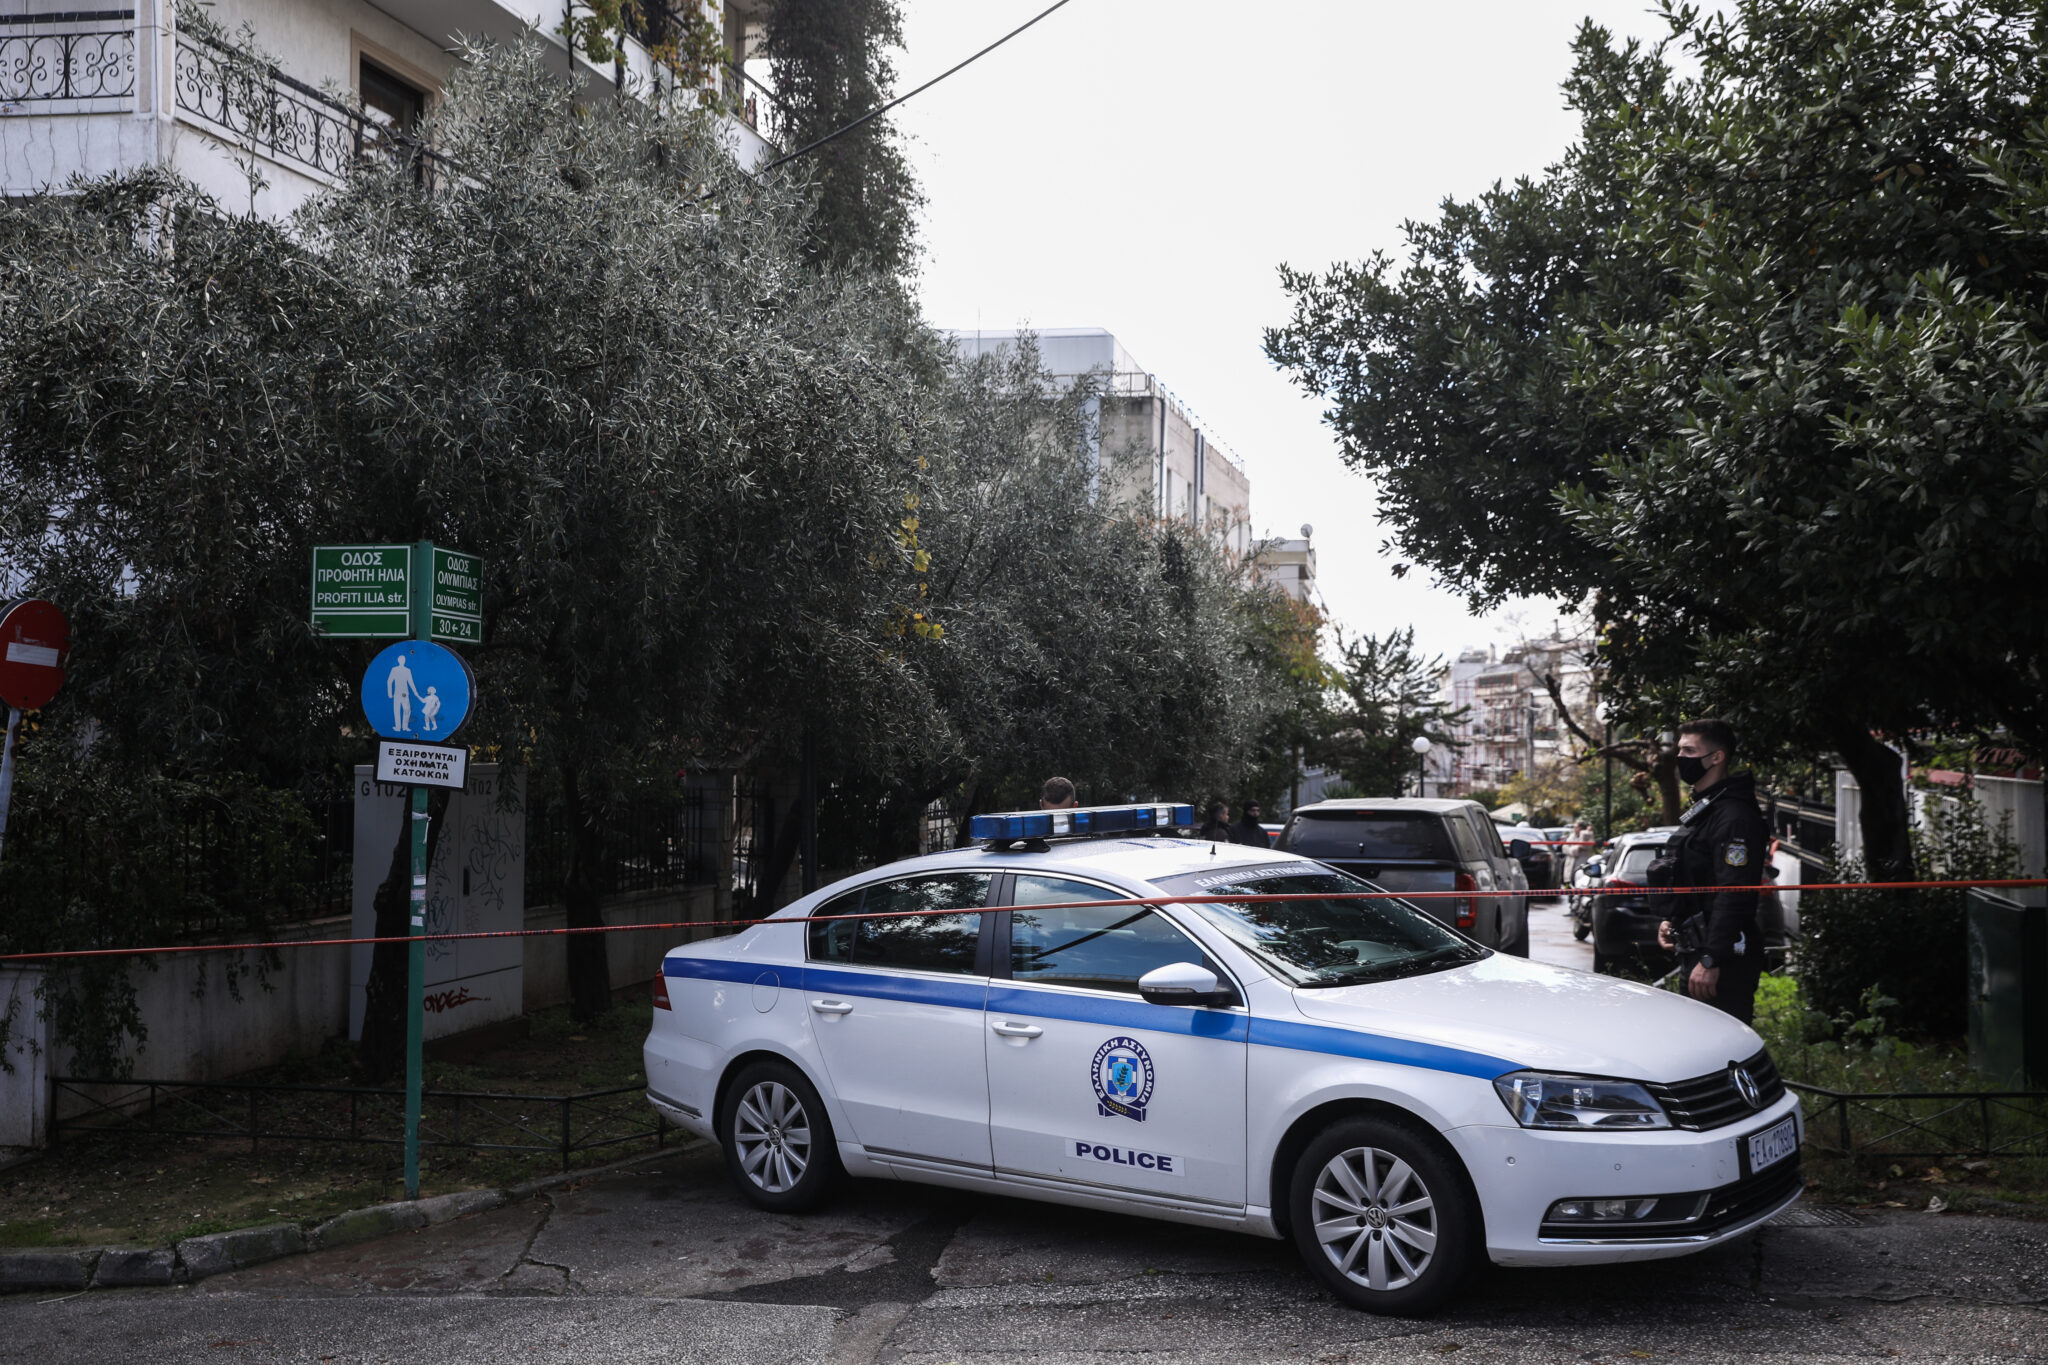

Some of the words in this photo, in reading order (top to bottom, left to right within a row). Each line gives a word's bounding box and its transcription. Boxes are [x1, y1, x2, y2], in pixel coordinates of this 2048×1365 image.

[341, 552, 383, 566] ΟΔΟΣ
[447, 556, 470, 573] ΟΔΟΣ
[318, 568, 375, 583] ΠΡΟΦΗΤΗ
[378, 568, 405, 582] ΗΛΙΑ
[437, 570, 478, 591] ΟΛΥΜΠΙΑΣ
[317, 592, 361, 604] PROFITI
[364, 592, 385, 603] ILIA
[387, 592, 405, 603] str.
[435, 593, 467, 610] OLYMPIAS
[467, 601, 478, 611] str.
[439, 619, 450, 634] 30
[460, 622, 471, 636] 24
[388, 748, 457, 762] ΕΞΑΙΡΟΥΝΤΑΙ
[395, 759, 449, 770] ΟΧΗΜΑΤΑ
[393, 768, 449, 780] ΚΑΤΟΙΚΩΝ
[1092, 1039, 1119, 1099] ΕΛΛΗΝΙΚΗ
[1121, 1039, 1153, 1103] ΑΣΤΥΝΟΜΙΑ
[1075, 1142, 1173, 1172] POLICE
